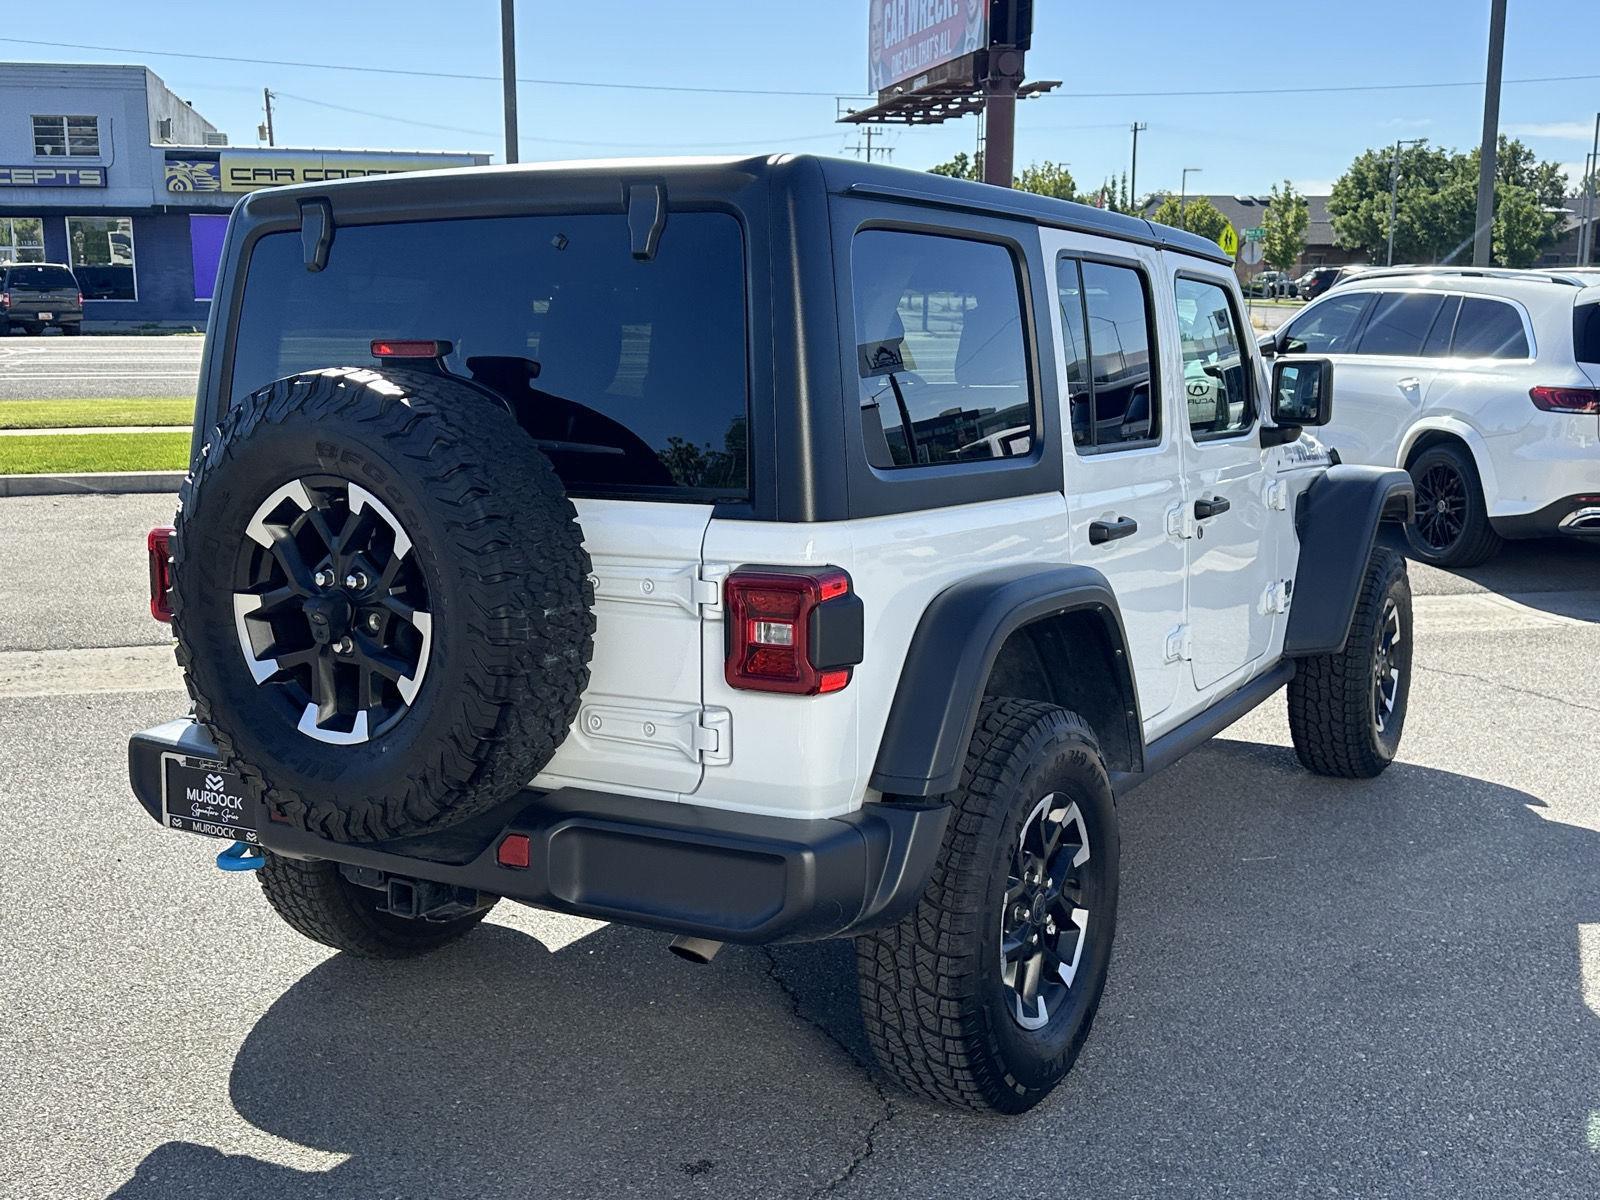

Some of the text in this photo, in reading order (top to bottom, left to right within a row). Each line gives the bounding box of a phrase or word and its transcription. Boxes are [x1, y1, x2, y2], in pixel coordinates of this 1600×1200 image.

[884, 0, 905, 49] CAR
[903, 44, 917, 72] CALL
[918, 32, 939, 66] THAT'S
[940, 29, 952, 57] ALL
[230, 168, 295, 181] CAR
[186, 787, 243, 810] MURDOCK
[192, 821, 236, 838] MURDOCK
